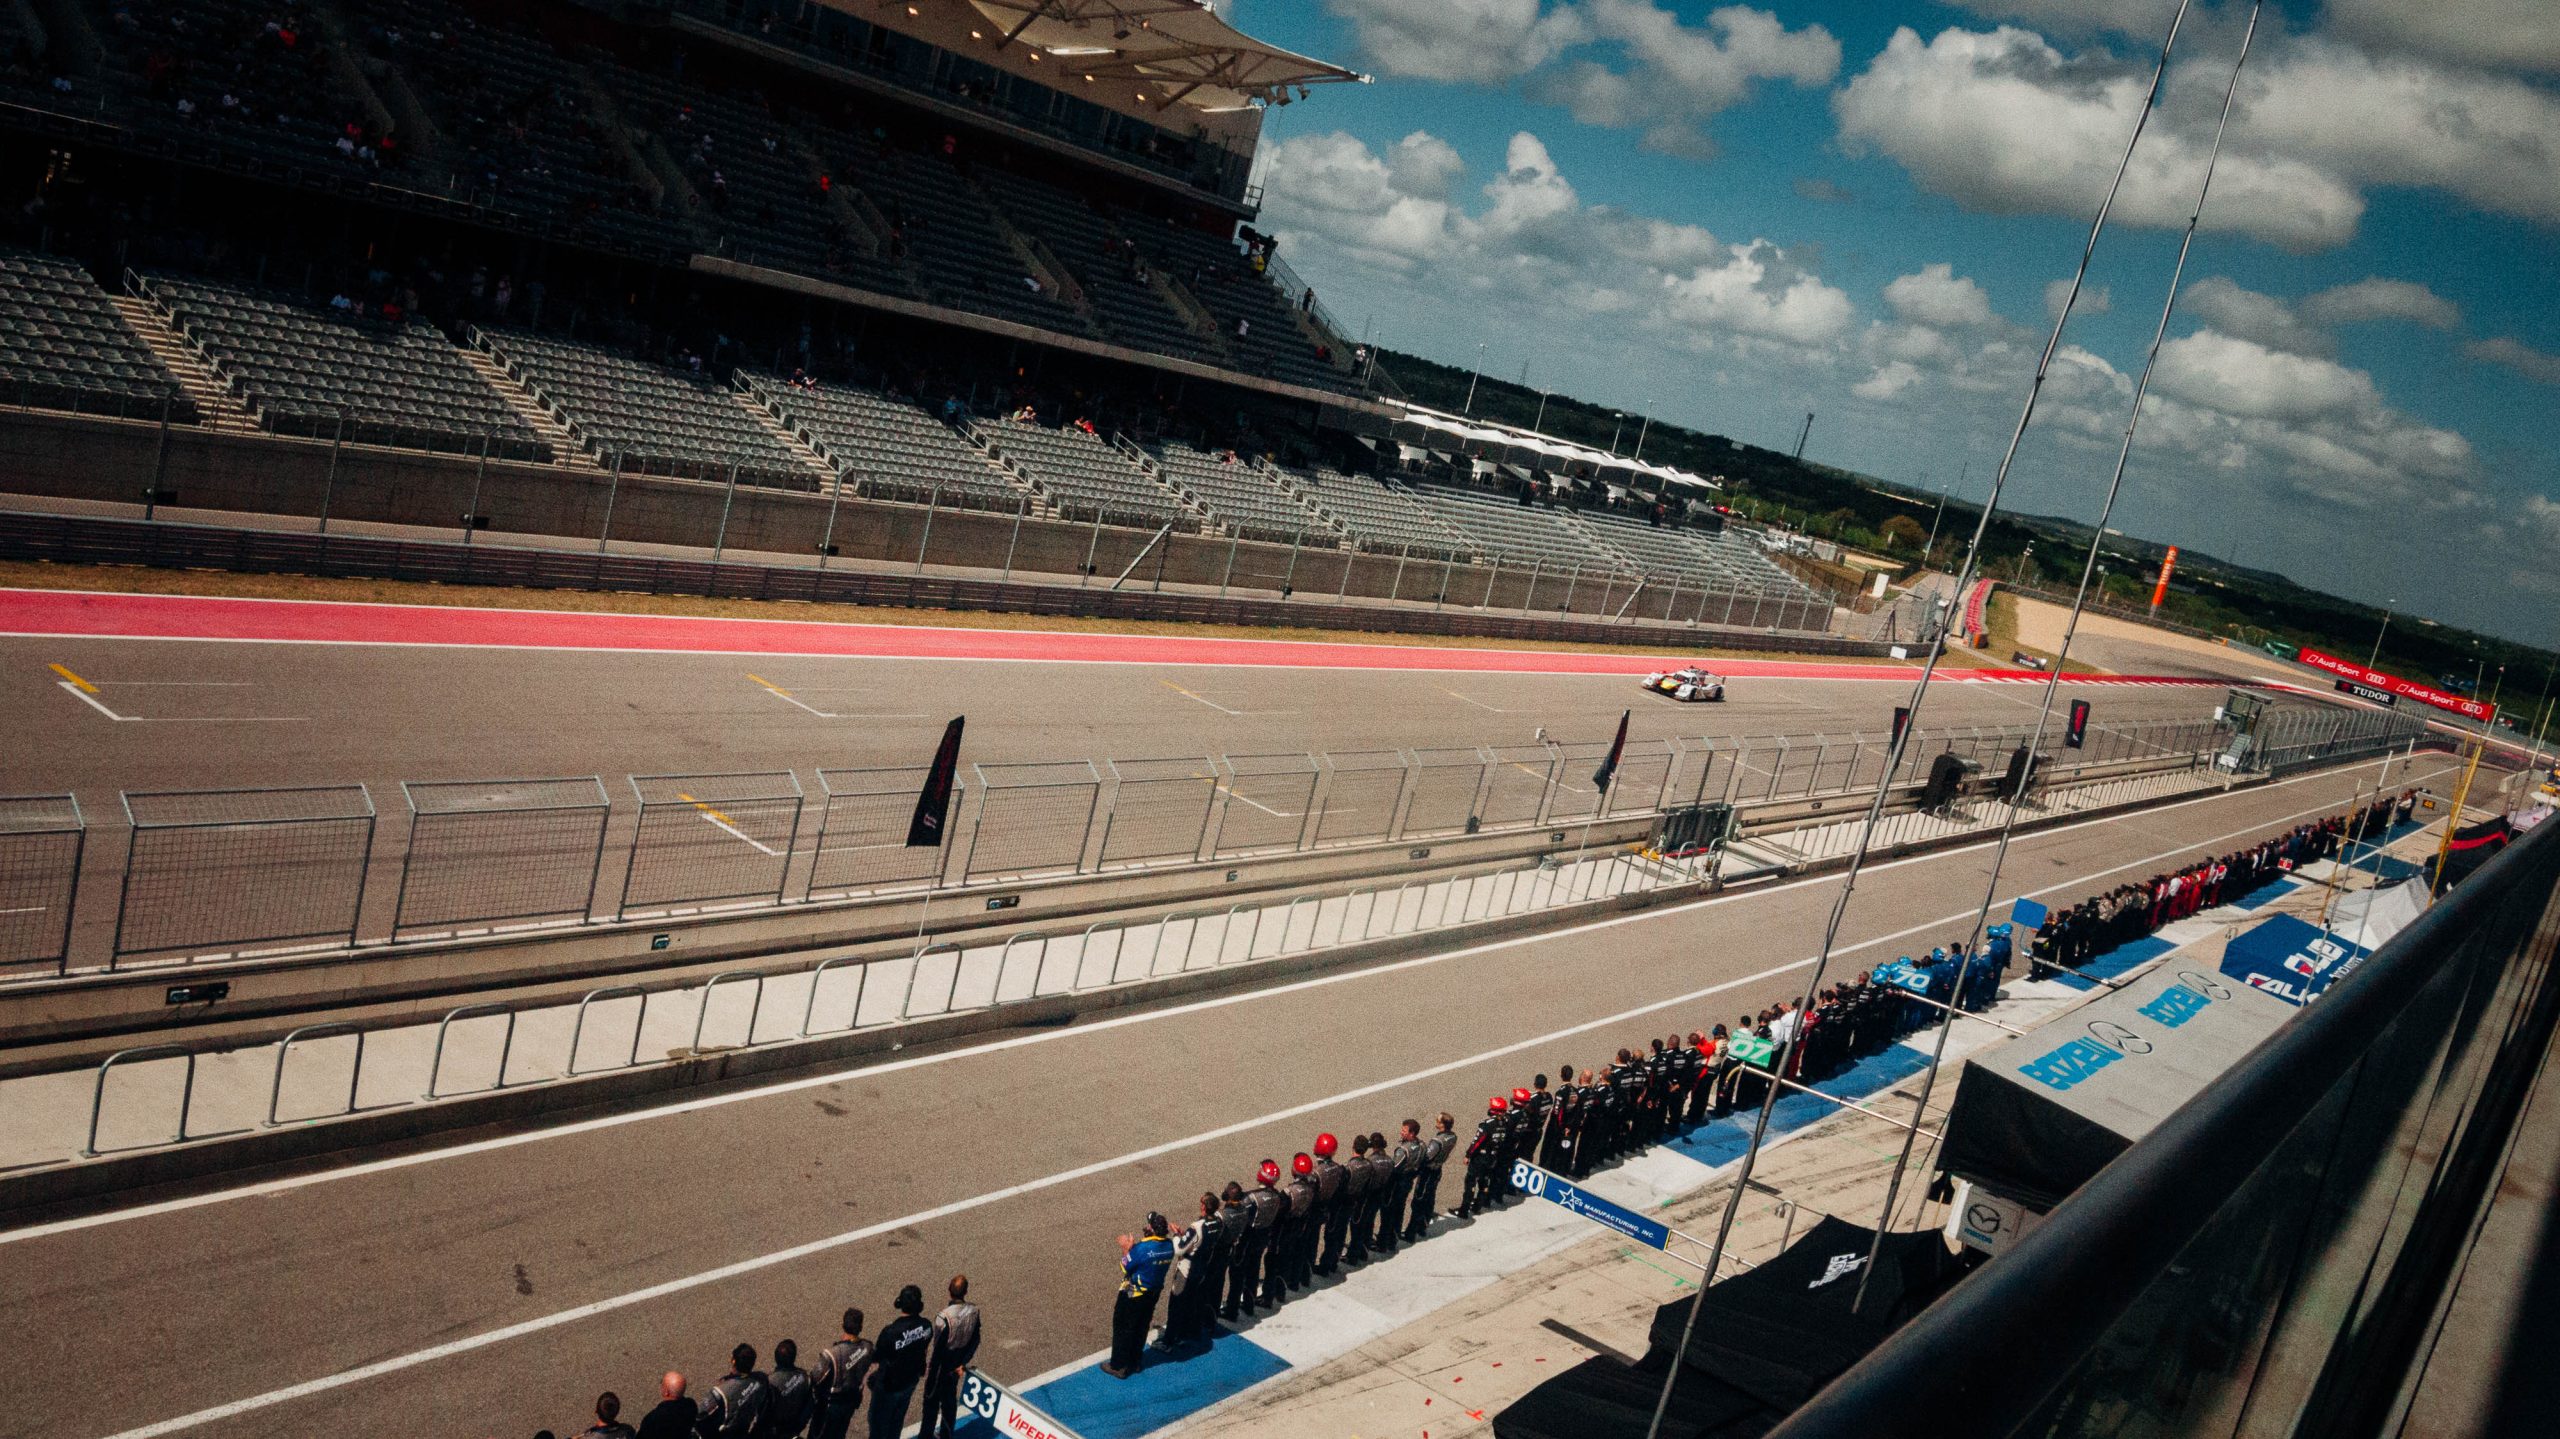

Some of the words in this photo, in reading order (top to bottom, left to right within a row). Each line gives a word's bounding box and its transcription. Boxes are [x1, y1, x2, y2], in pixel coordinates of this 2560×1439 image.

[2317, 657, 2336, 669] Audi
[2336, 663, 2360, 677] Sport
[2353, 686, 2390, 703] TUDOR
[2408, 687, 2428, 698] Audi
[2430, 693, 2455, 706] Sport
[1891, 969, 1930, 989] 70
[1727, 1039, 1774, 1060] 07
[1511, 1162, 1544, 1195] 80
[962, 1376, 998, 1419] 33
